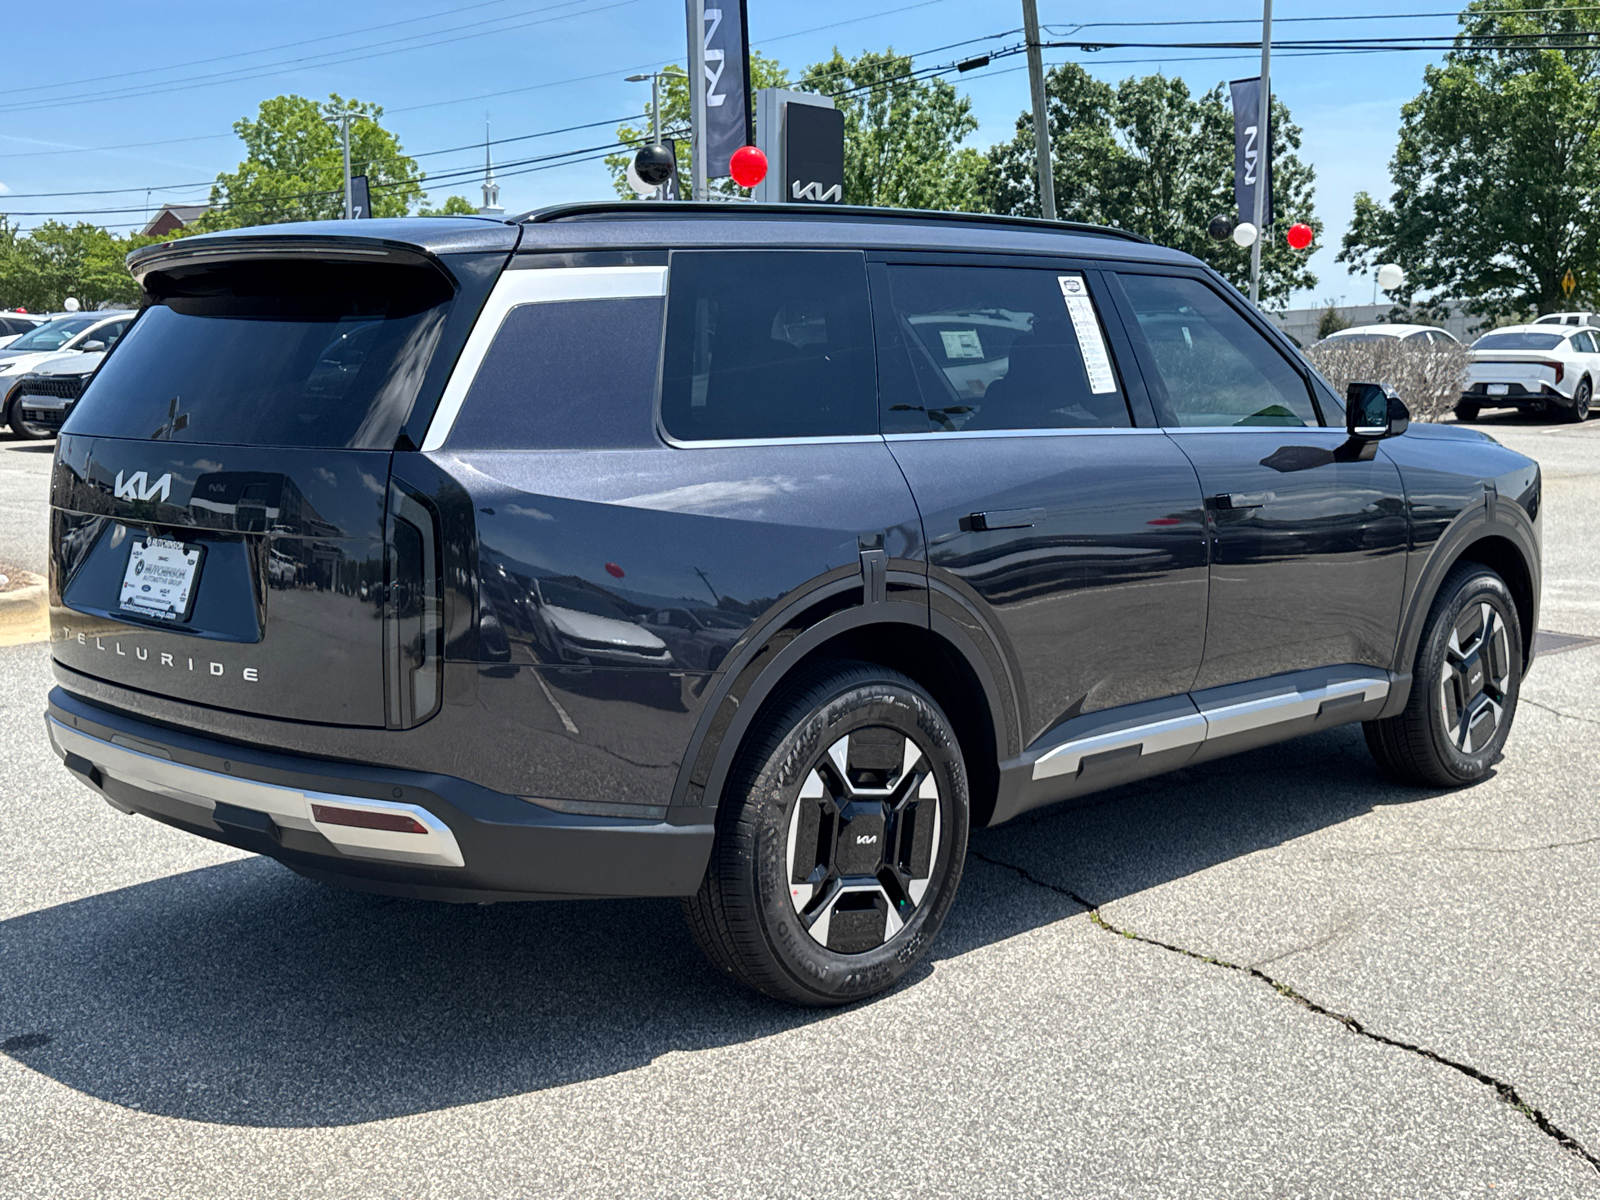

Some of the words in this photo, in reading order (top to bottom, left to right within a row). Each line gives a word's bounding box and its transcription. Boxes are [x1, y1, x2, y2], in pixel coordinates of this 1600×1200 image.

[792, 180, 842, 202] KIA
[114, 469, 172, 502] KIA
[144, 563, 187, 580] HUTCHINSON
[63, 626, 259, 682] TELLURIDE
[856, 835, 877, 845] KIA
[776, 920, 829, 982] KUMHO
